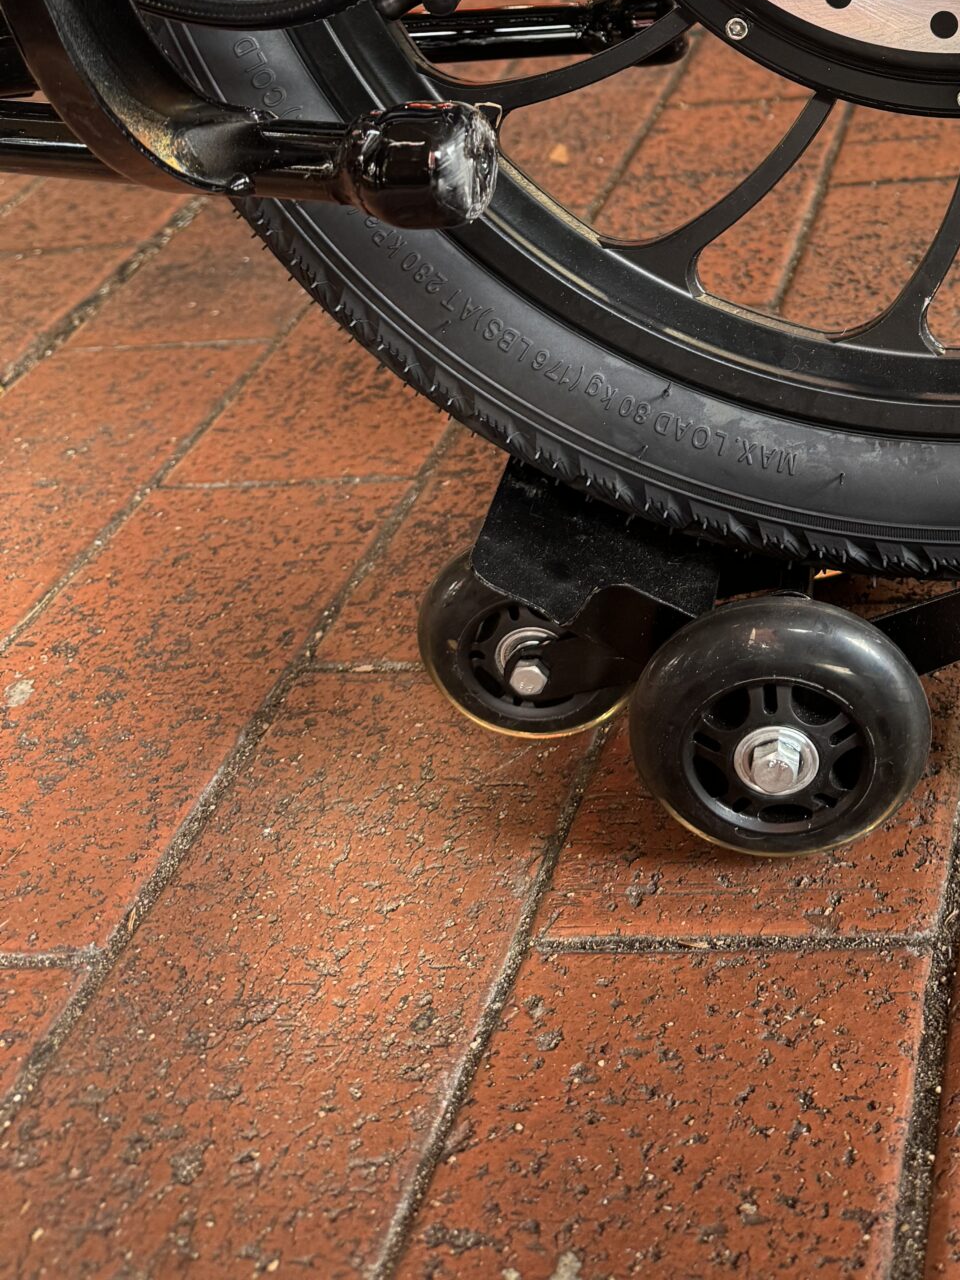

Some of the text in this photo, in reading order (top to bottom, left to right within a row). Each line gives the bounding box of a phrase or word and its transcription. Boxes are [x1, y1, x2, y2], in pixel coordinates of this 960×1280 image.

[618, 394, 652, 426] 80
[653, 411, 729, 457] LOAD
[735, 437, 799, 476] MAX.
